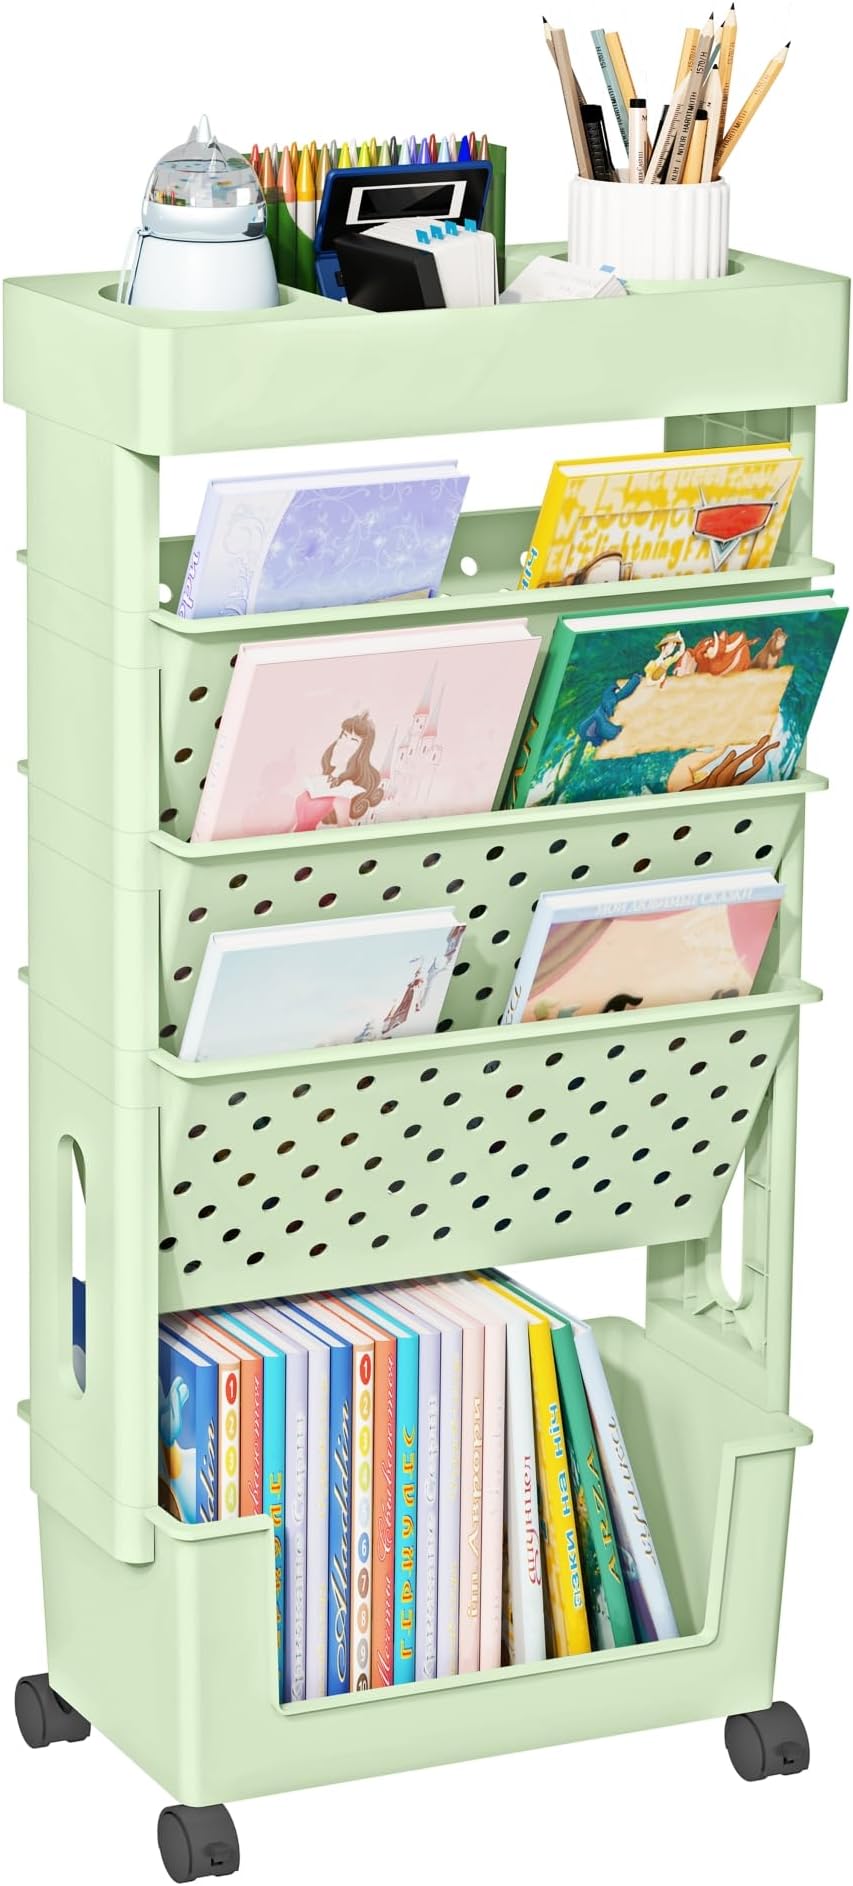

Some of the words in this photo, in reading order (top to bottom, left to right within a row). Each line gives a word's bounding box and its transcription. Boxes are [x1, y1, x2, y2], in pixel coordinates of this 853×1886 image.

[696, 51, 708, 74] 1570/H
[678, 135, 688, 156] NOOR
[548, 1402, 564, 1459] ніч
[558, 1470, 572, 1517] на
[331, 1399, 350, 1683] Aladdin
[401, 1424, 416, 1660] ГЕРКУЛЕС
